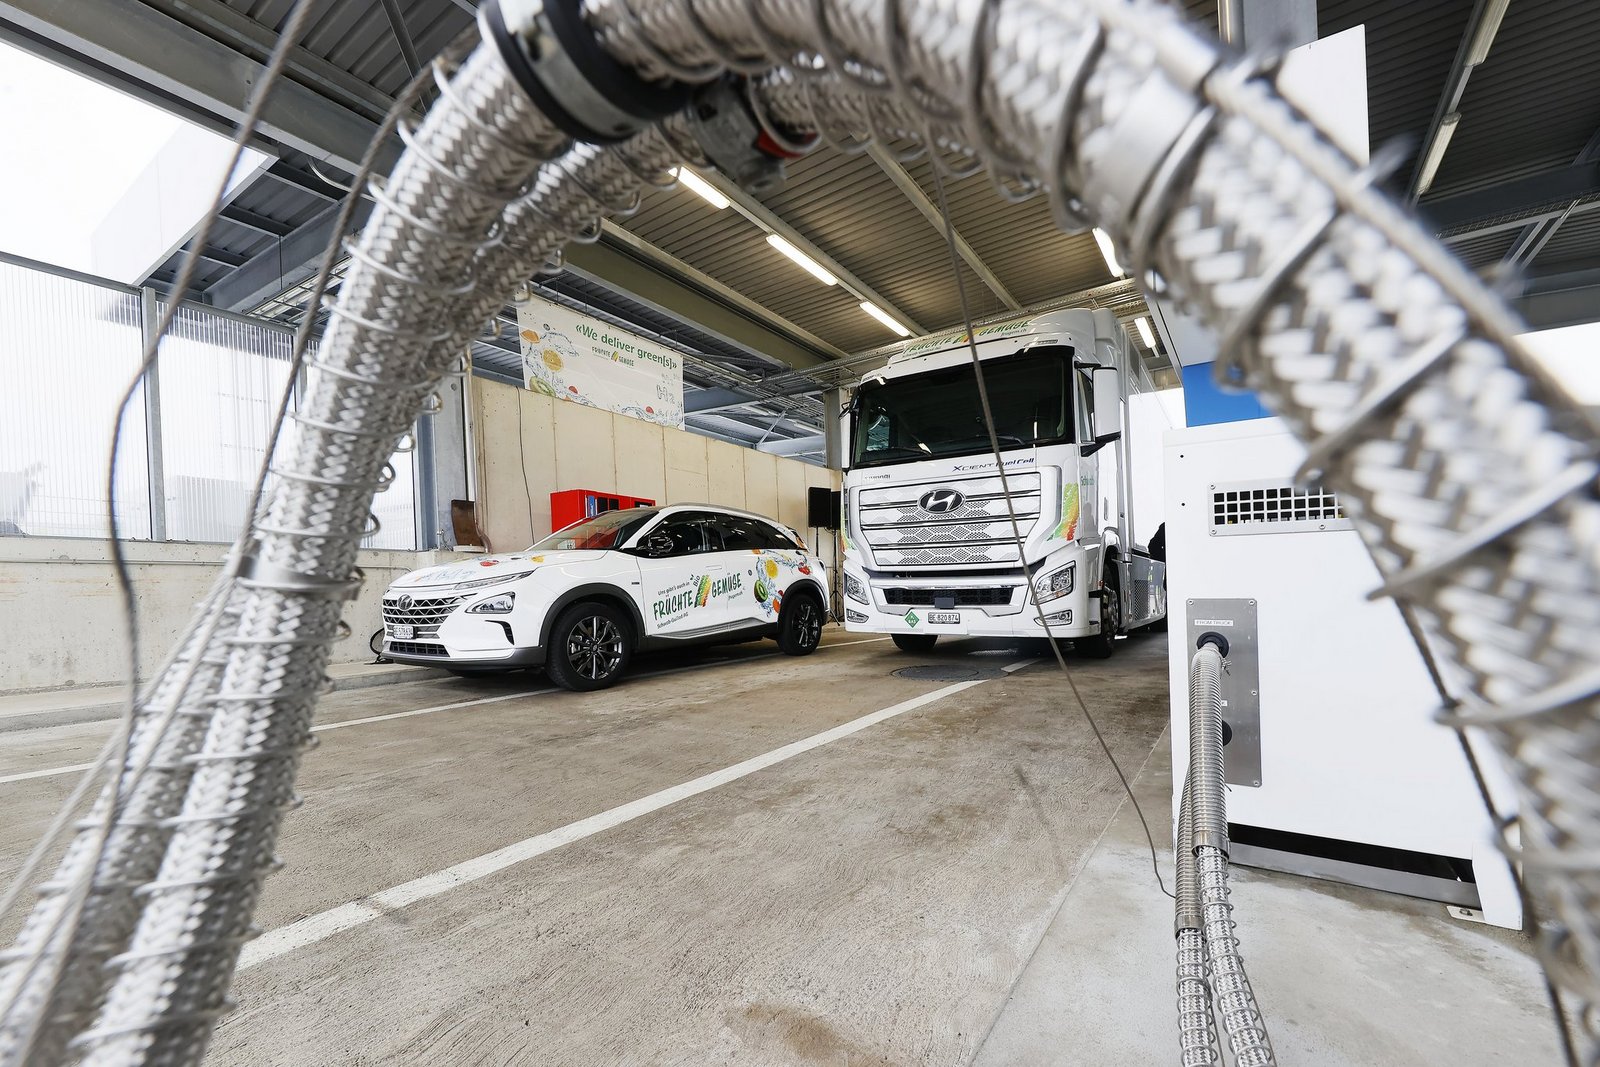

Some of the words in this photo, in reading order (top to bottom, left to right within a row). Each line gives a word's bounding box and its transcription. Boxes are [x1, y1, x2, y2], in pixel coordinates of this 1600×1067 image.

[575, 323, 598, 341] «We
[601, 334, 635, 354] deliver
[637, 345, 678, 370] green[s]»
[952, 462, 994, 473] XCIENT
[1016, 457, 1035, 465] Cell
[653, 590, 693, 620] FRÜCHTE
[711, 572, 742, 598] GEMÜSE
[676, 582, 686, 590] auch
[692, 575, 701, 587] Bio
